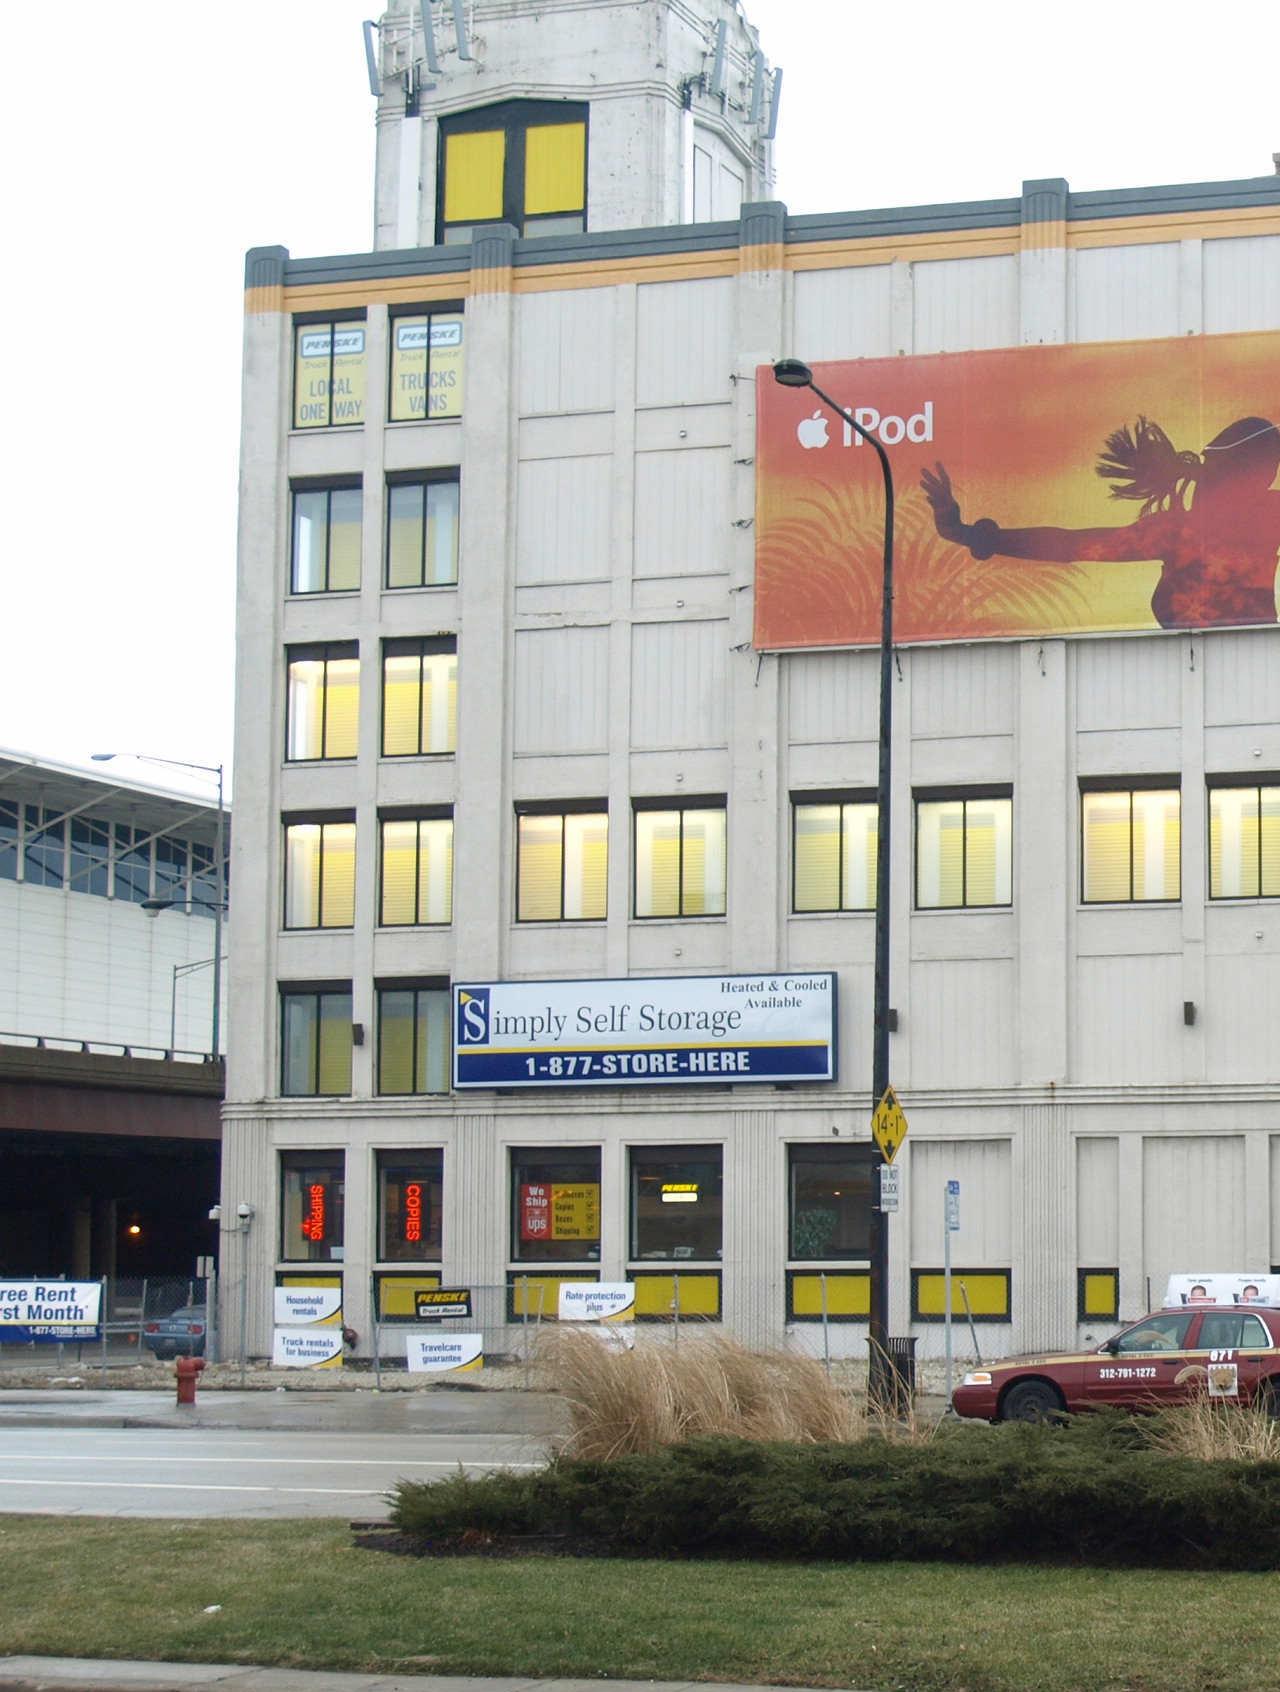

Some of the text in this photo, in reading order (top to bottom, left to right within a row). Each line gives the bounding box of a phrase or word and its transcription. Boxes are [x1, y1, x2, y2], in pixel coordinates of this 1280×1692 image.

[401, 328, 458, 342] PENSKE
[305, 336, 360, 350] PENSKE
[400, 370, 457, 390] TRUCKS
[301, 399, 362, 420] ONE WAY
[409, 394, 448, 412] VANS
[842, 401, 934, 447] iPod
[721, 979, 828, 993] Heated & Cooled
[744, 996, 803, 1009] Available
[463, 999, 742, 1042] Simply Self Storage
[526, 1051, 750, 1077] 1-877-STORE-HERE
[529, 1186, 545, 1196] We
[526, 1197, 548, 1208] Ship
[310, 1184, 324, 1241] SHIPPING
[406, 1184, 421, 1241] COPIES
[528, 1219, 547, 1233] ups
[35, 1286, 77, 1302] Rent
[286, 1296, 324, 1305] Household
[417, 1291, 469, 1303] PENSKE
[565, 1290, 626, 1301] Rate protection
[292, 1307, 318, 1316] rentals
[282, 1336, 334, 1348] Truck rentals
[421, 1343, 462, 1352] Travelcare
[422, 1354, 462, 1364] guarantee
